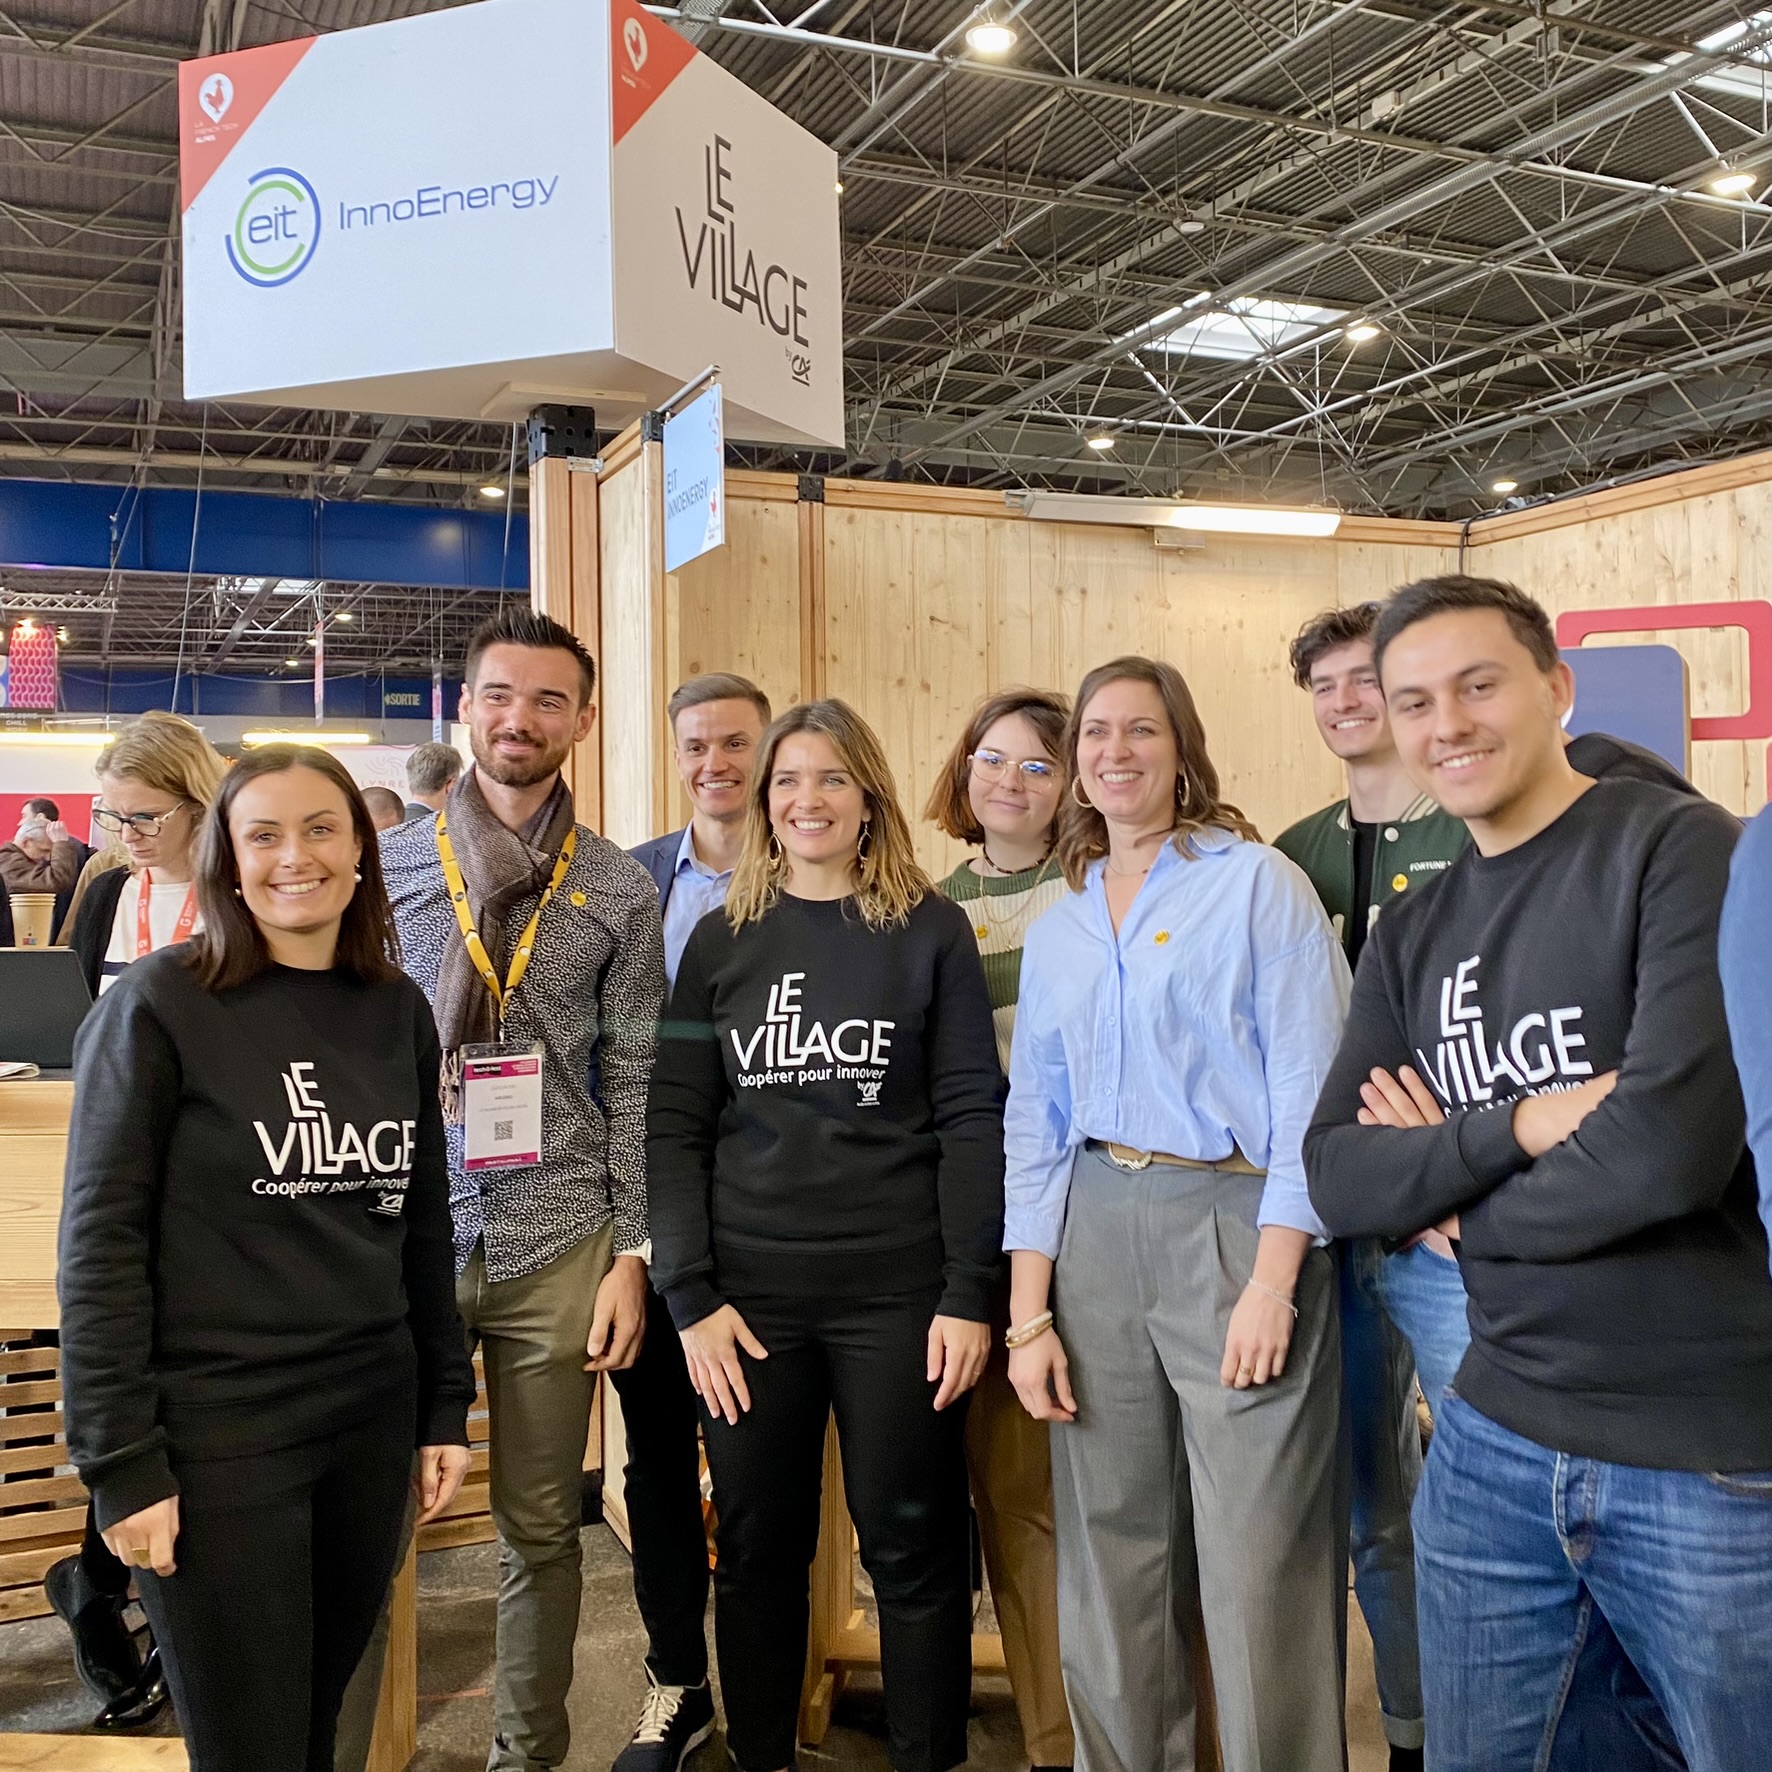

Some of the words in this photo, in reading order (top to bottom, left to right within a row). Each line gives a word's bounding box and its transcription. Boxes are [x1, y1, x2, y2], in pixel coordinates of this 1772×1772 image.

[705, 133, 734, 225] LE
[248, 205, 297, 244] eit
[339, 175, 559, 230] InnoEnergy
[675, 206, 809, 348] VILLAGE
[667, 468, 678, 494] EIT
[390, 694, 421, 706] SORTIE
[766, 972, 806, 1023] LE
[1440, 955, 1482, 1037] LE
[730, 1014, 896, 1070] VILLAGE
[1416, 1006, 1593, 1105] VILLAGE
[281, 1062, 326, 1118] LE
[737, 1069, 794, 1089] Coopérer
[798, 1067, 833, 1086] pour
[836, 1064, 886, 1080] innover
[253, 1111, 416, 1175] VILLAGE
[252, 1177, 329, 1199] Coopérer
[327, 1180, 366, 1194] pour
